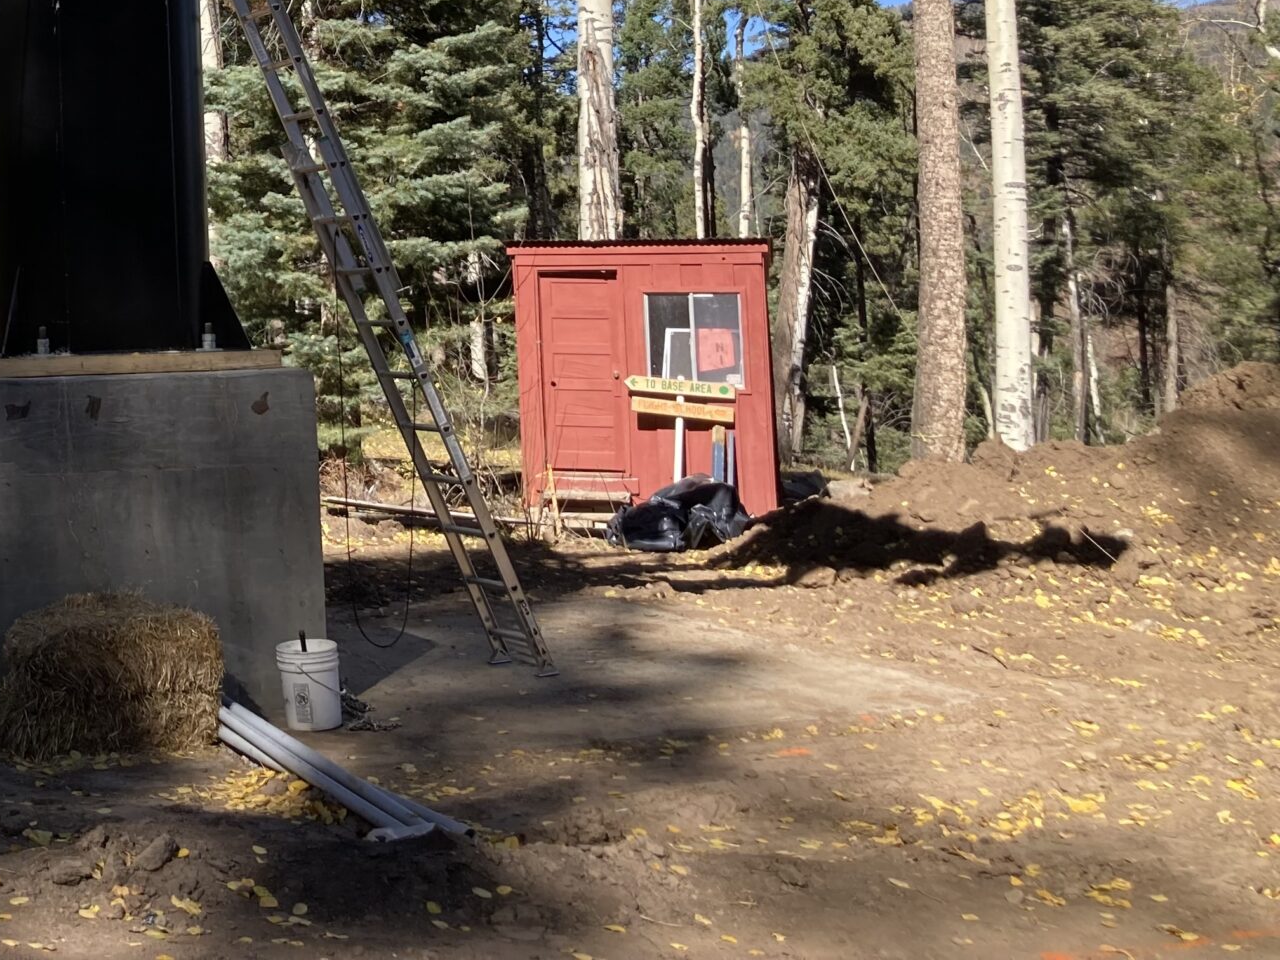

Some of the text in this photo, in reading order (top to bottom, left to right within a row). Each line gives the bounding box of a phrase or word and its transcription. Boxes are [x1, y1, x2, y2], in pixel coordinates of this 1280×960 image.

[645, 378, 712, 394] TO BASE AREA
